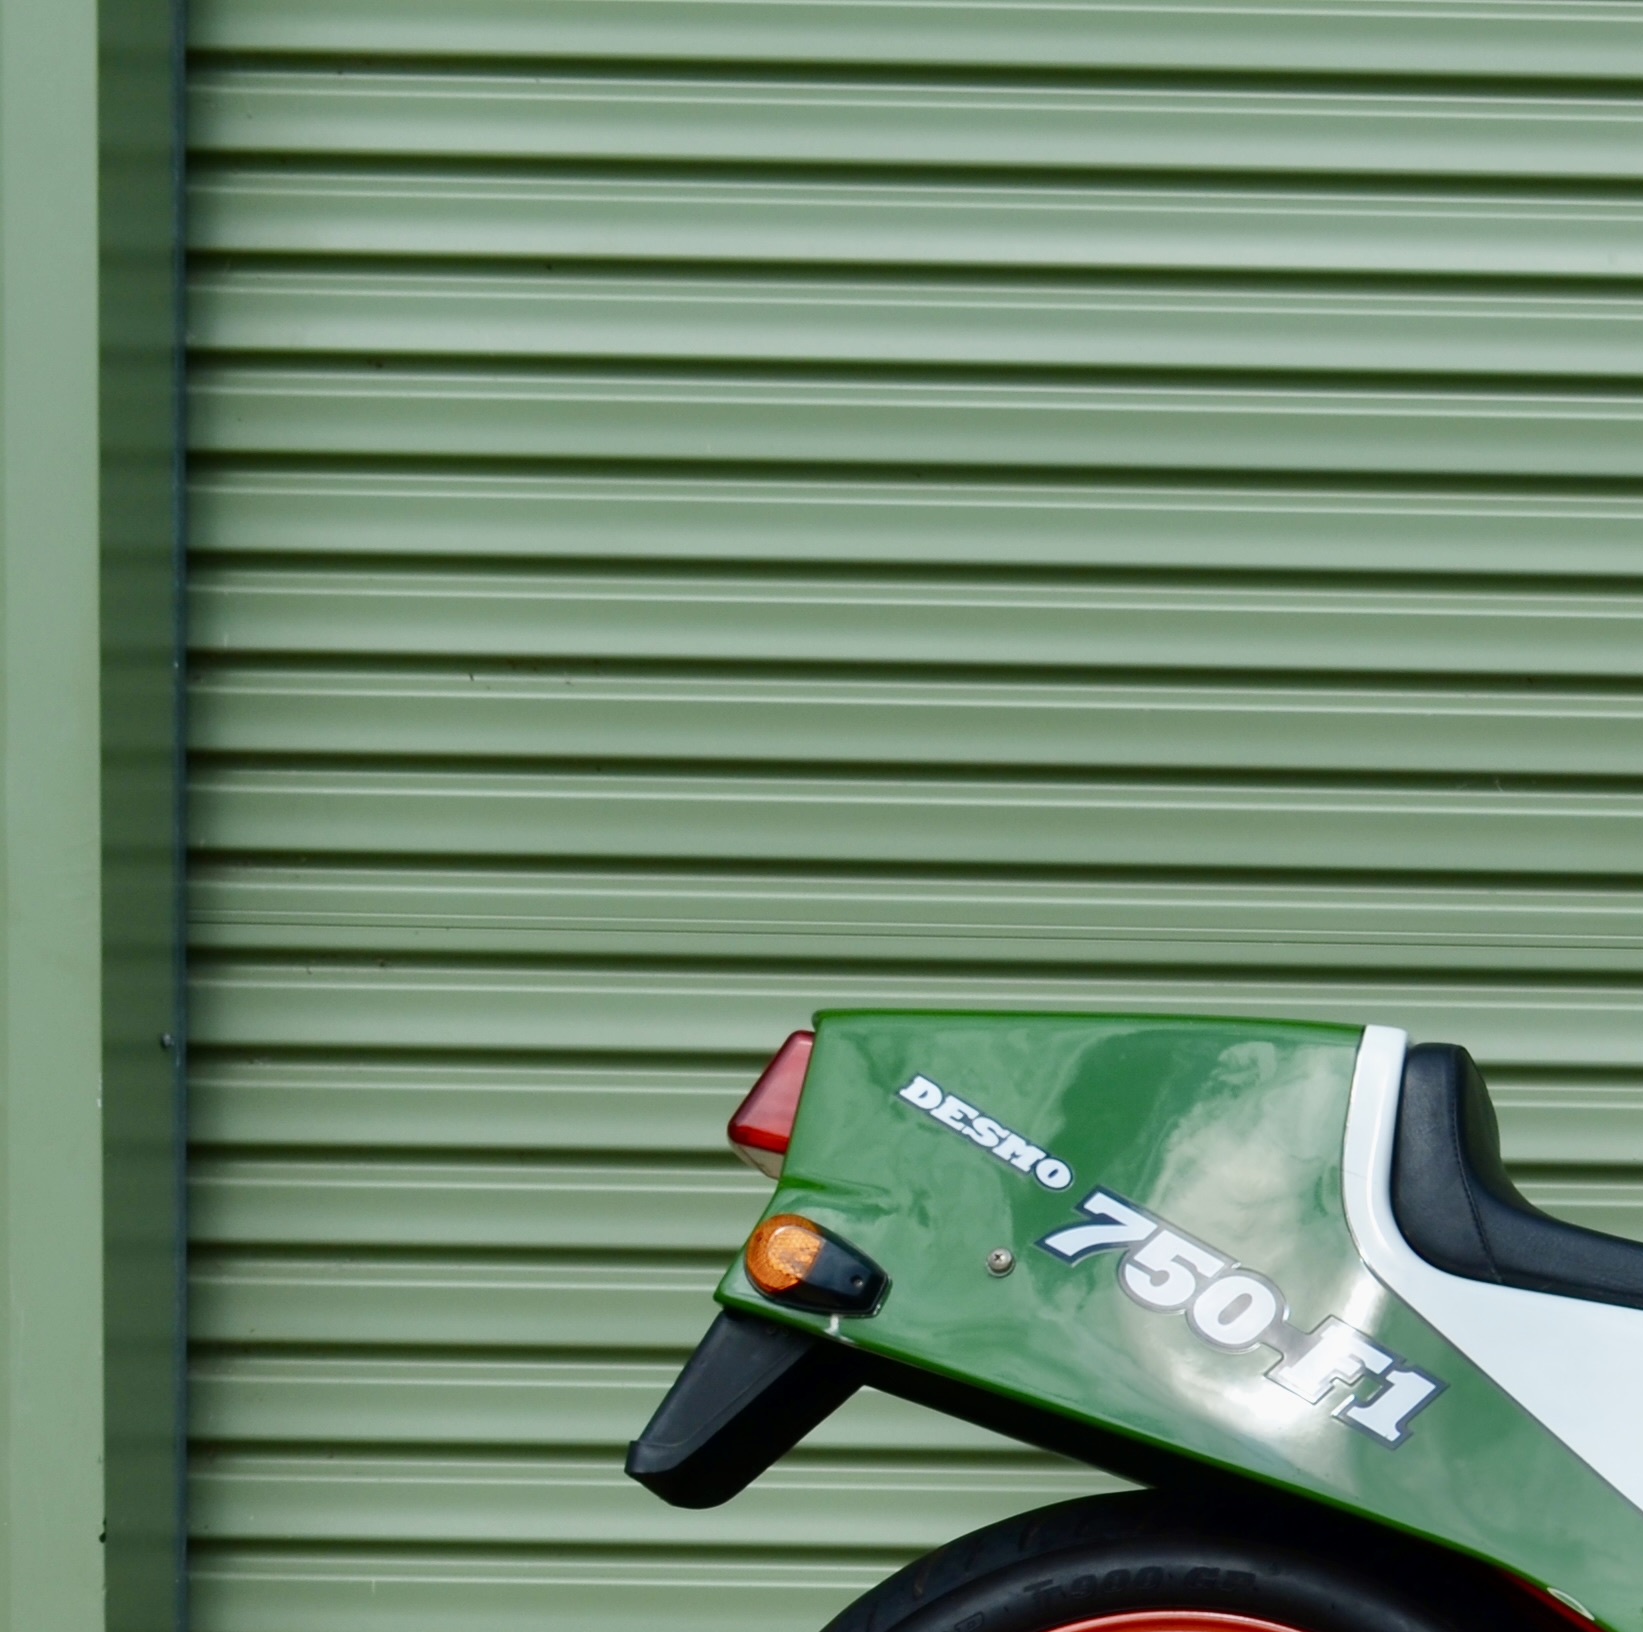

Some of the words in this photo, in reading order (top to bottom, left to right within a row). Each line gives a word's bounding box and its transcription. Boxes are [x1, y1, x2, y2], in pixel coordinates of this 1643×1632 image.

[897, 1074, 1074, 1191] DESMO
[1040, 1188, 1282, 1350] 750
[1274, 1316, 1446, 1446] F1
